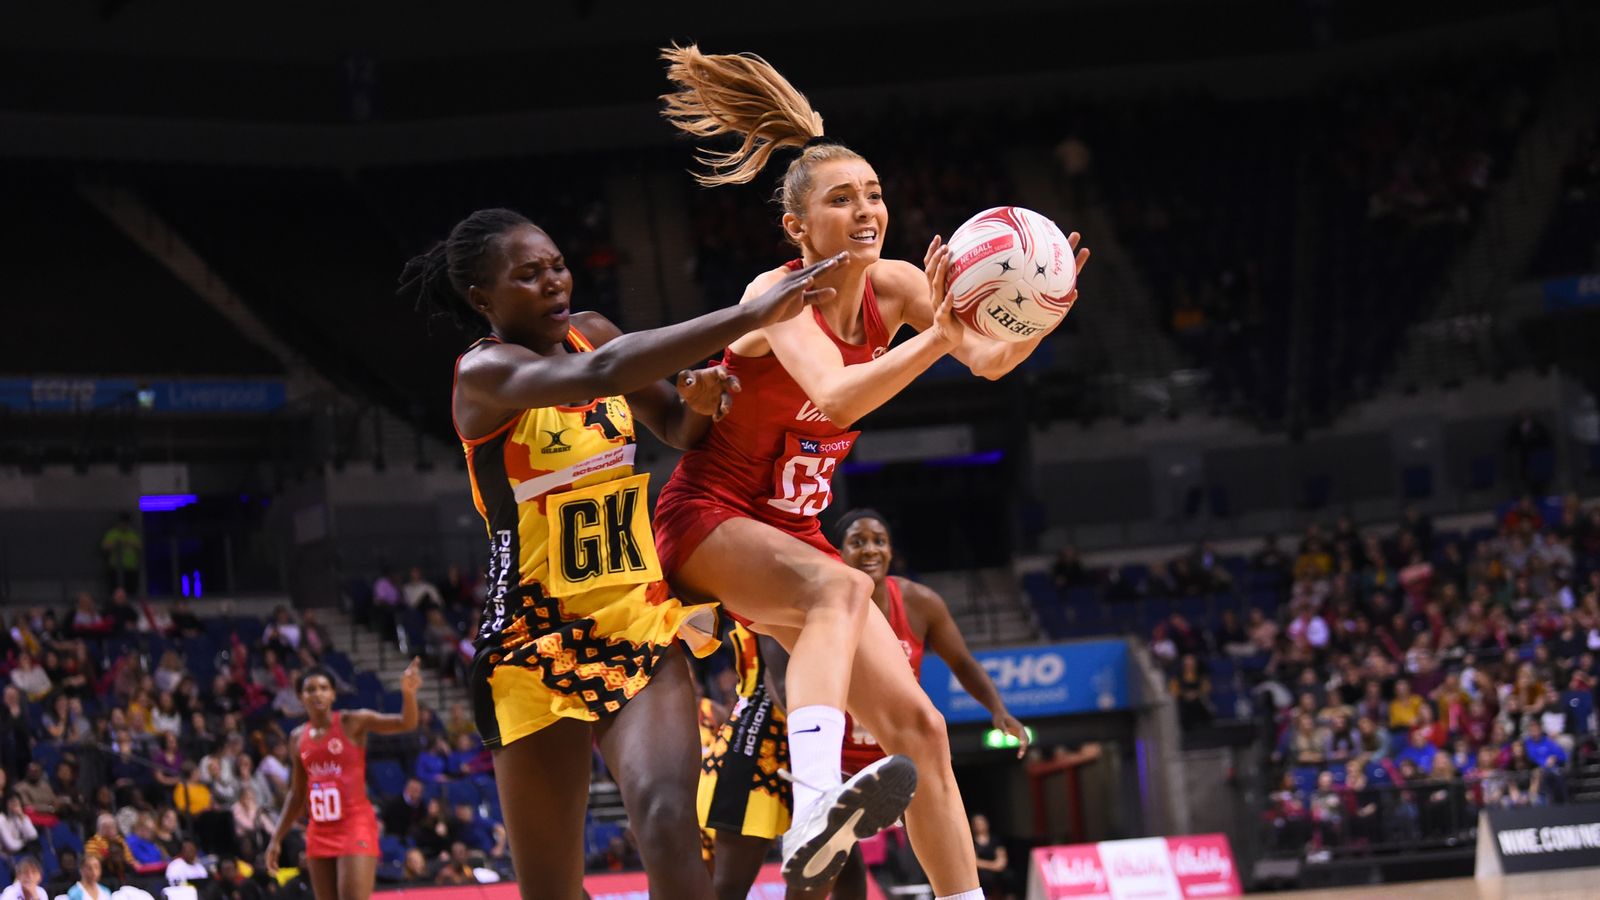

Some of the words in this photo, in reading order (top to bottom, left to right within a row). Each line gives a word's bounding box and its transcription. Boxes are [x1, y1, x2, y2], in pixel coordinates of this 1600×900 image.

[960, 241, 993, 266] NETBALL
[987, 305, 1042, 336] BERT
[541, 445, 572, 455] GILBERT
[801, 441, 817, 453] sky
[819, 440, 851, 454] sports
[558, 487, 647, 583] GK
[949, 653, 1066, 692] CHO
